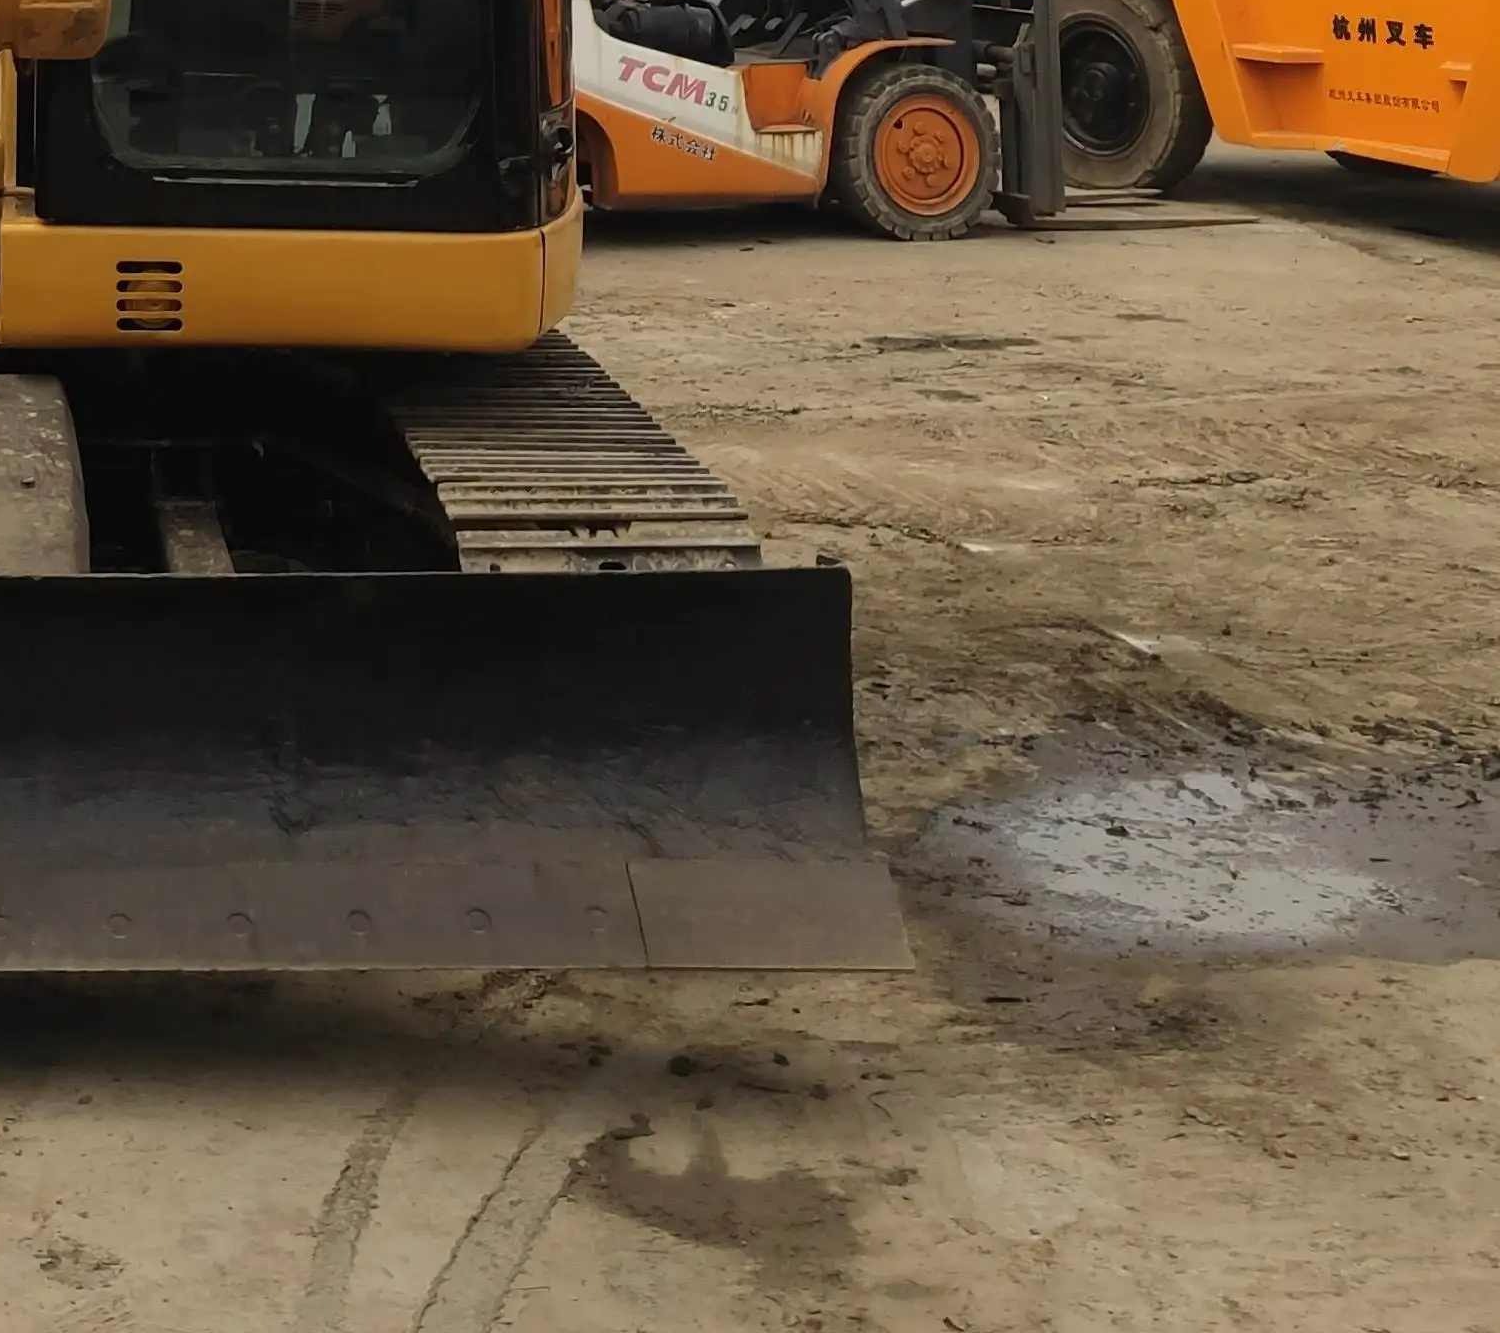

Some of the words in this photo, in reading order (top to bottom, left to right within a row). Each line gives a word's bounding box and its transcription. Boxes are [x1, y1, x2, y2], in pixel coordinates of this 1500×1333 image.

[1332, 14, 1435, 50] 杭州叉车
[618, 55, 707, 106] TCM
[705, 91, 730, 112] 35
[651, 125, 717, 162] 株式会社
